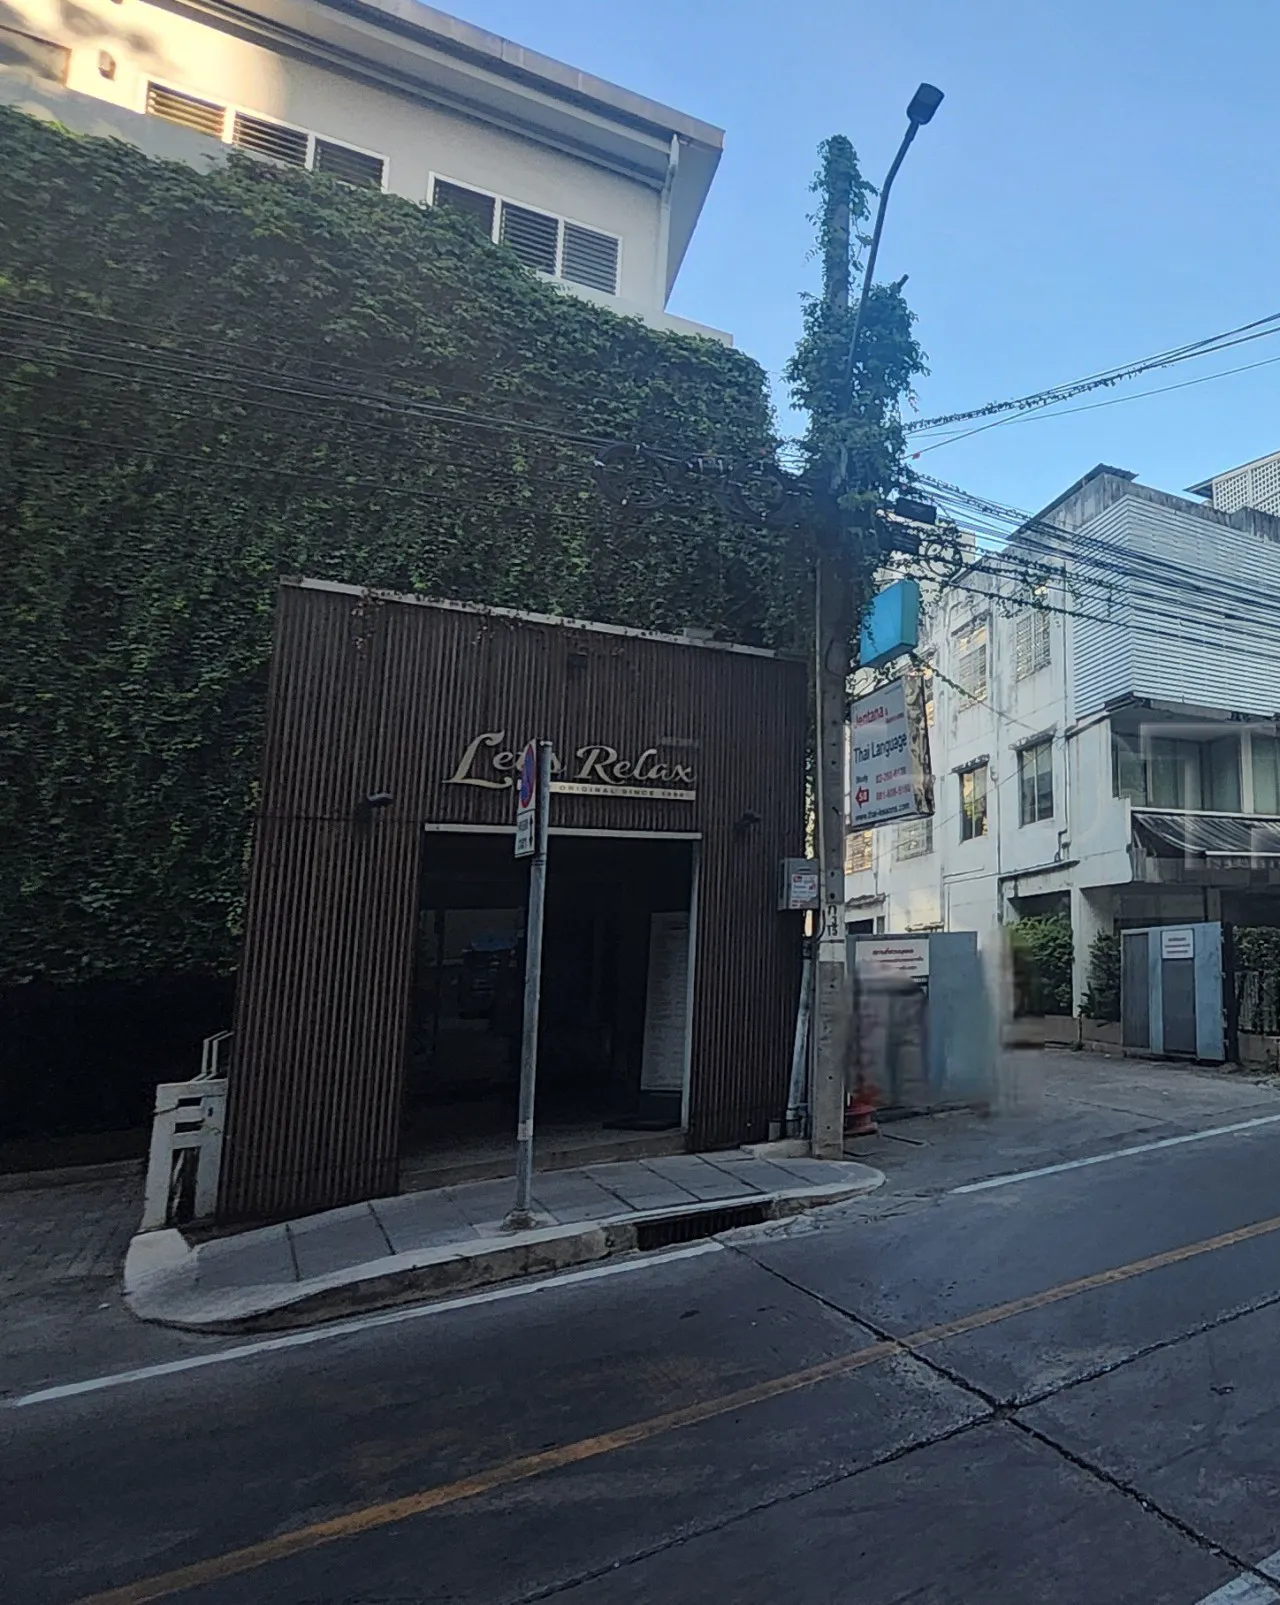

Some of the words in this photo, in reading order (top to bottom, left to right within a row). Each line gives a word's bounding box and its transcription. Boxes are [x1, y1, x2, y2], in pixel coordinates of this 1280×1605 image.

[853, 744, 870, 764] Thai
[871, 733, 908, 758] Language
[573, 745, 698, 784] Relax
[559, 785, 619, 794] ORIGINAL
[621, 788, 655, 796] SINCE
